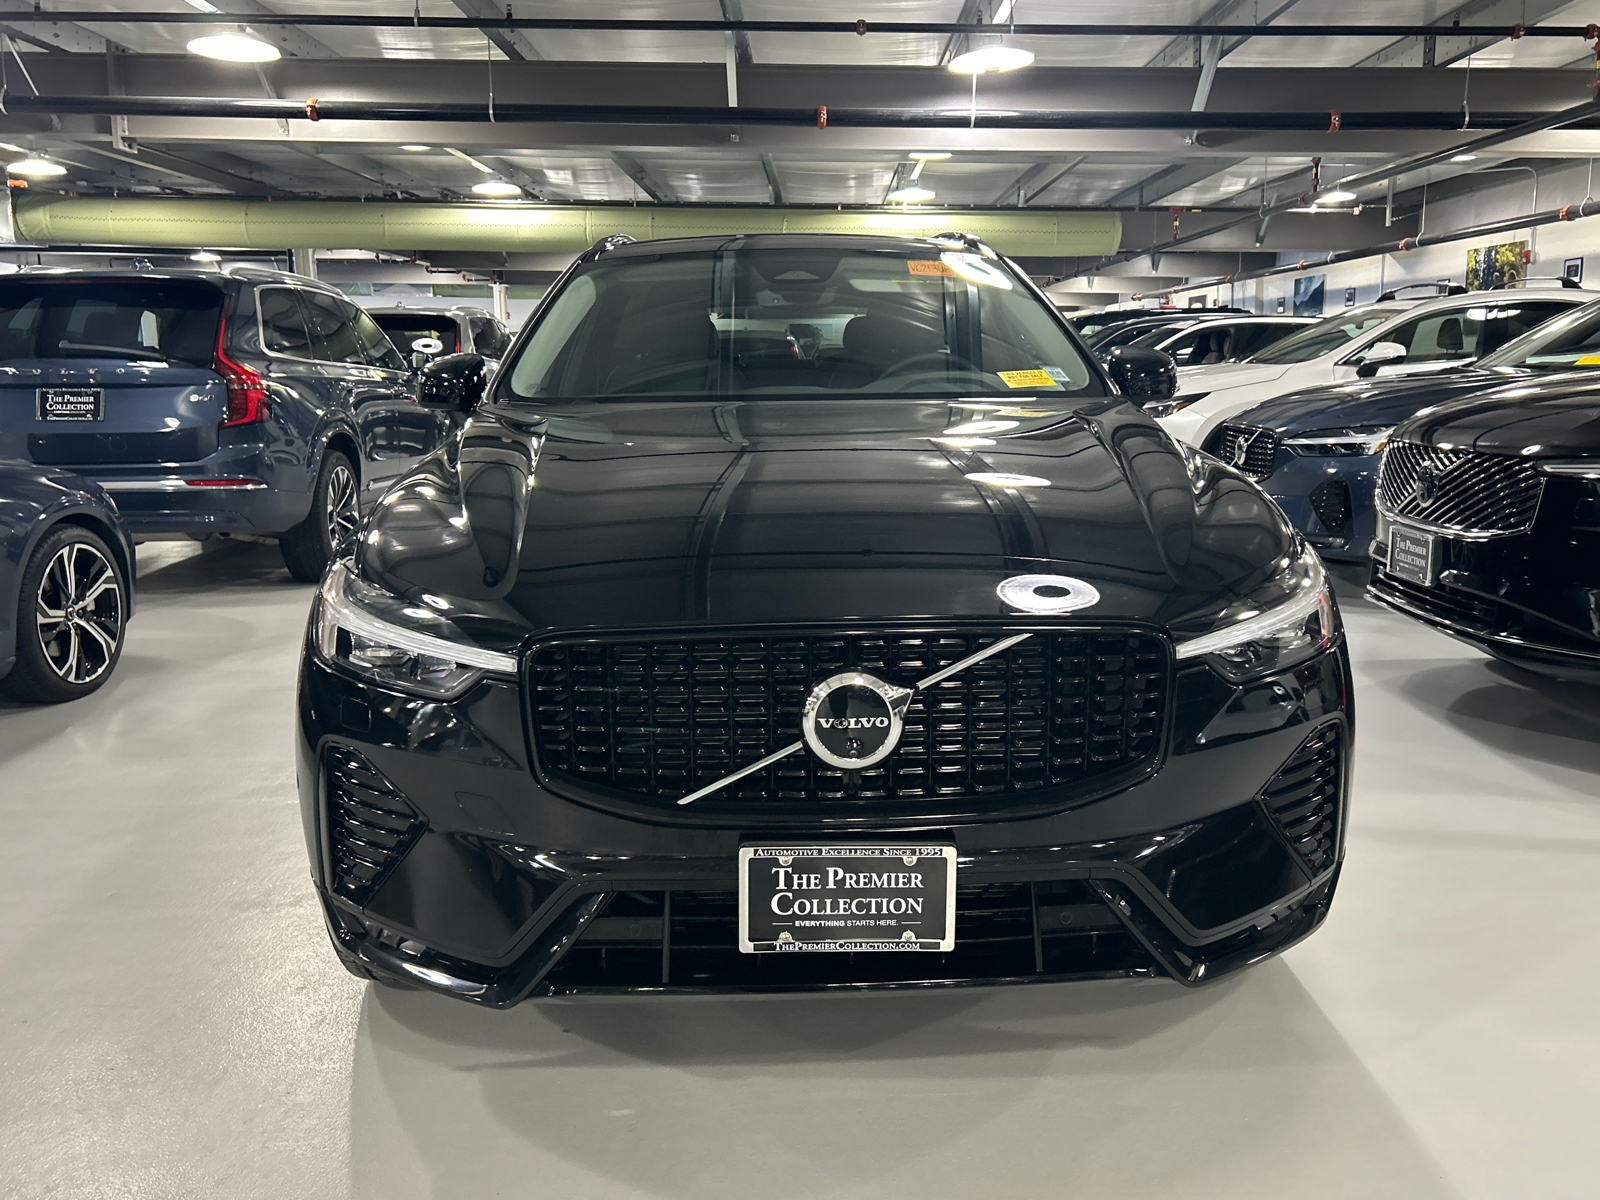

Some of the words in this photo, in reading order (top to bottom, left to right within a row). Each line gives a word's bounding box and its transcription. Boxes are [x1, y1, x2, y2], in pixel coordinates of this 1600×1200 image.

[817, 717, 889, 728] VOLVO
[915, 848, 941, 856] 1995
[771, 867, 822, 890] THE
[825, 867, 925, 889] PREMIER
[770, 891, 924, 916] COLLECTION
